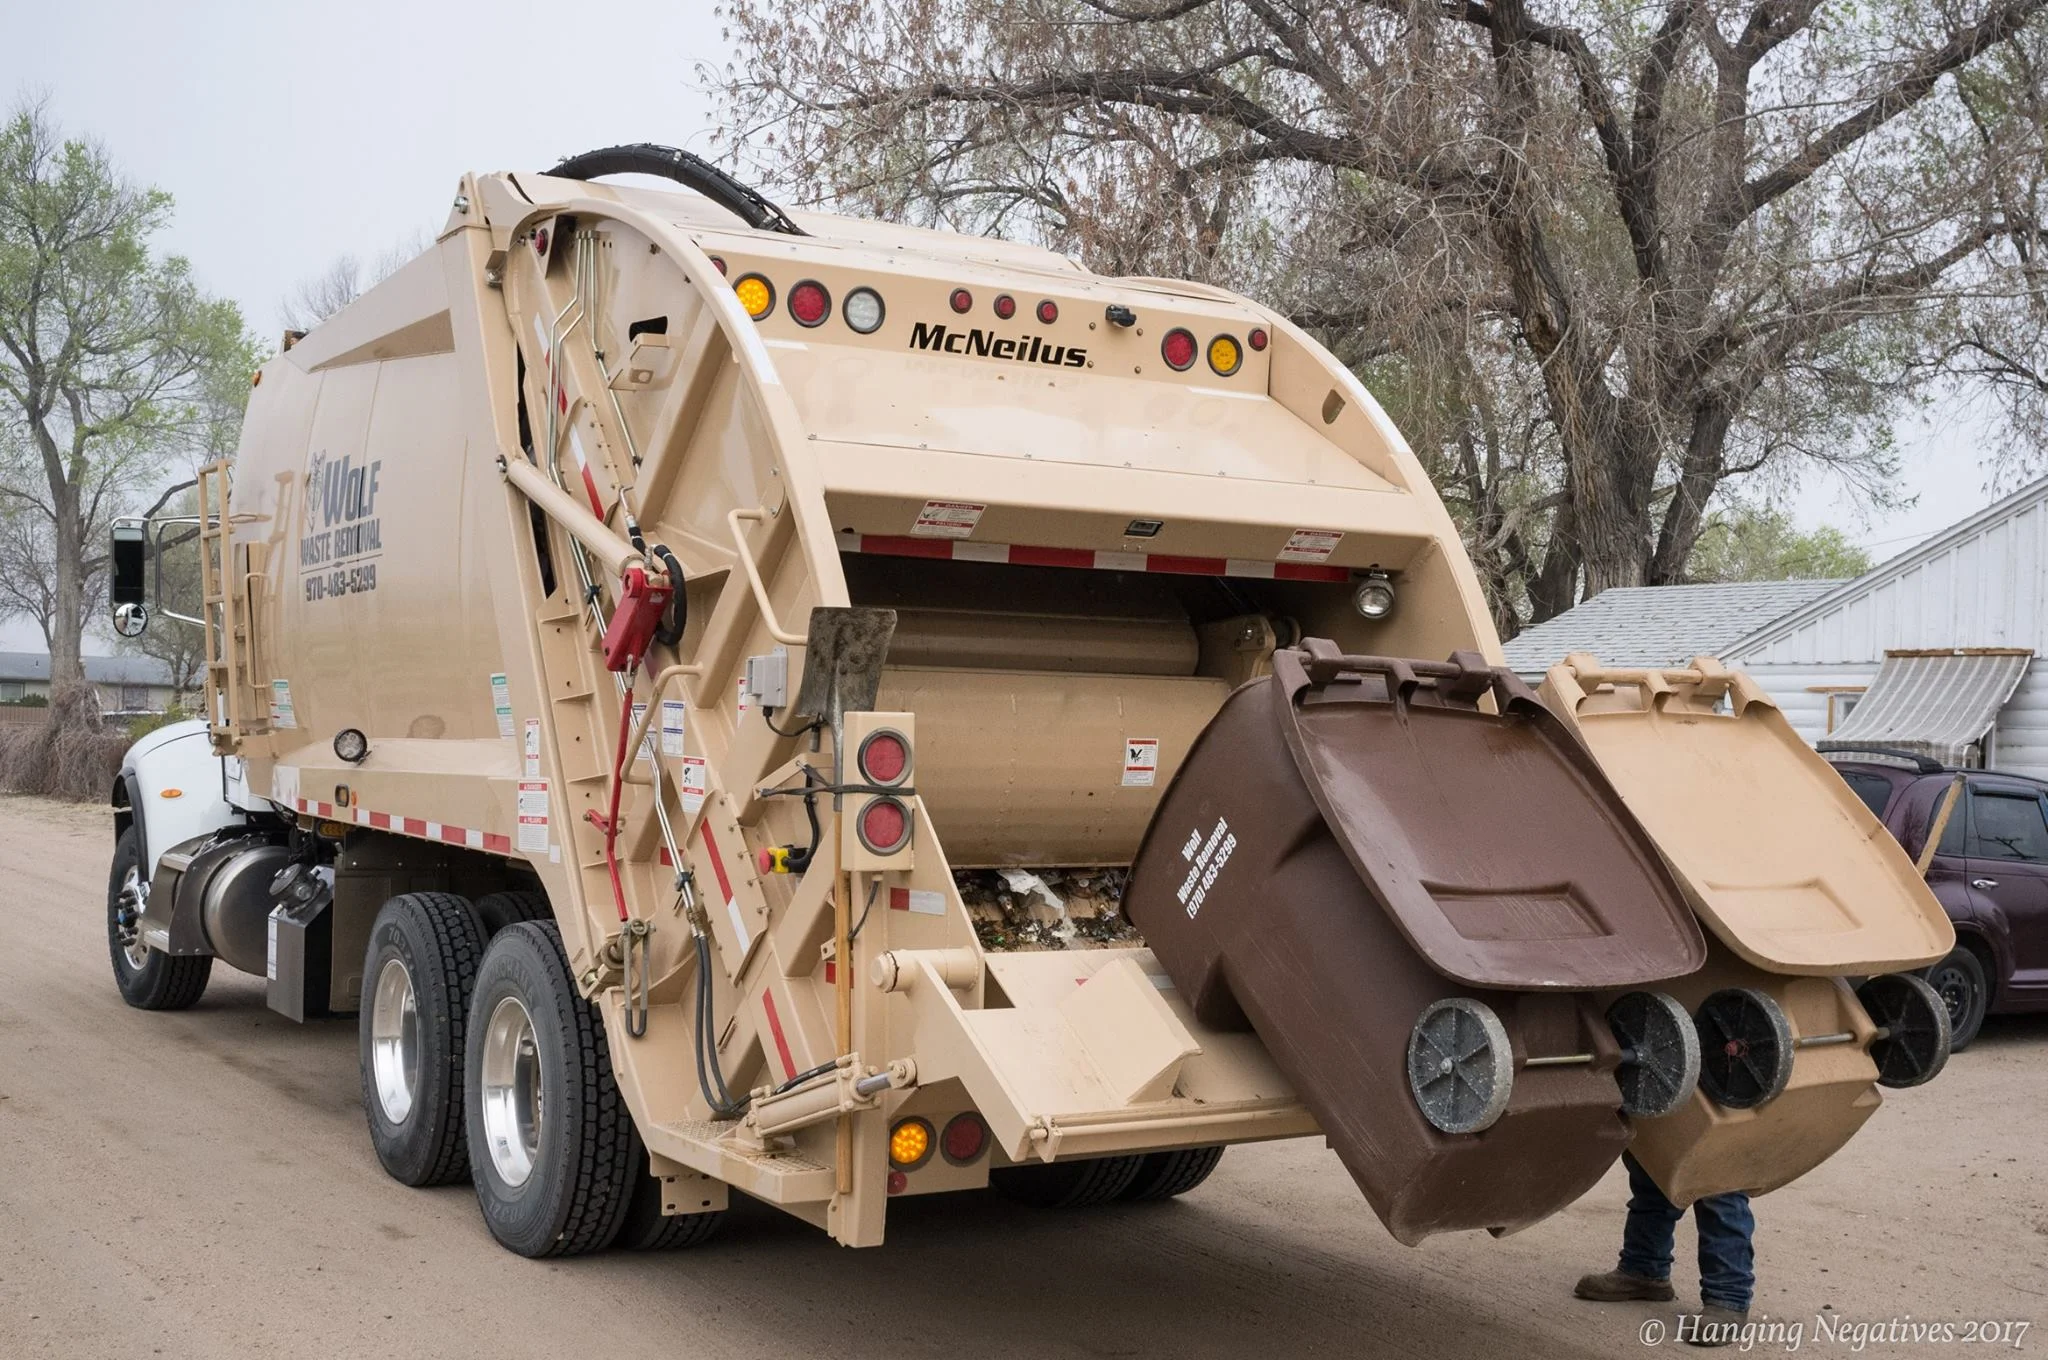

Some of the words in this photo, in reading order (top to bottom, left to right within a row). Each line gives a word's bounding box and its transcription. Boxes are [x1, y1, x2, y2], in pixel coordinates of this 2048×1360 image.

[909, 322, 1087, 368] McNeilus
[323, 454, 382, 528] WOLF
[301, 531, 331, 567] WASTE
[333, 518, 382, 560] REMOVAL
[306, 564, 377, 602] 970-483-5299
[1177, 865, 1200, 905] Waste
[1195, 816, 1228, 871] Removal
[1181, 828, 1202, 862] Wolf
[1186, 885, 1206, 920] (970)
[1201, 832, 1237, 891] 483-5299
